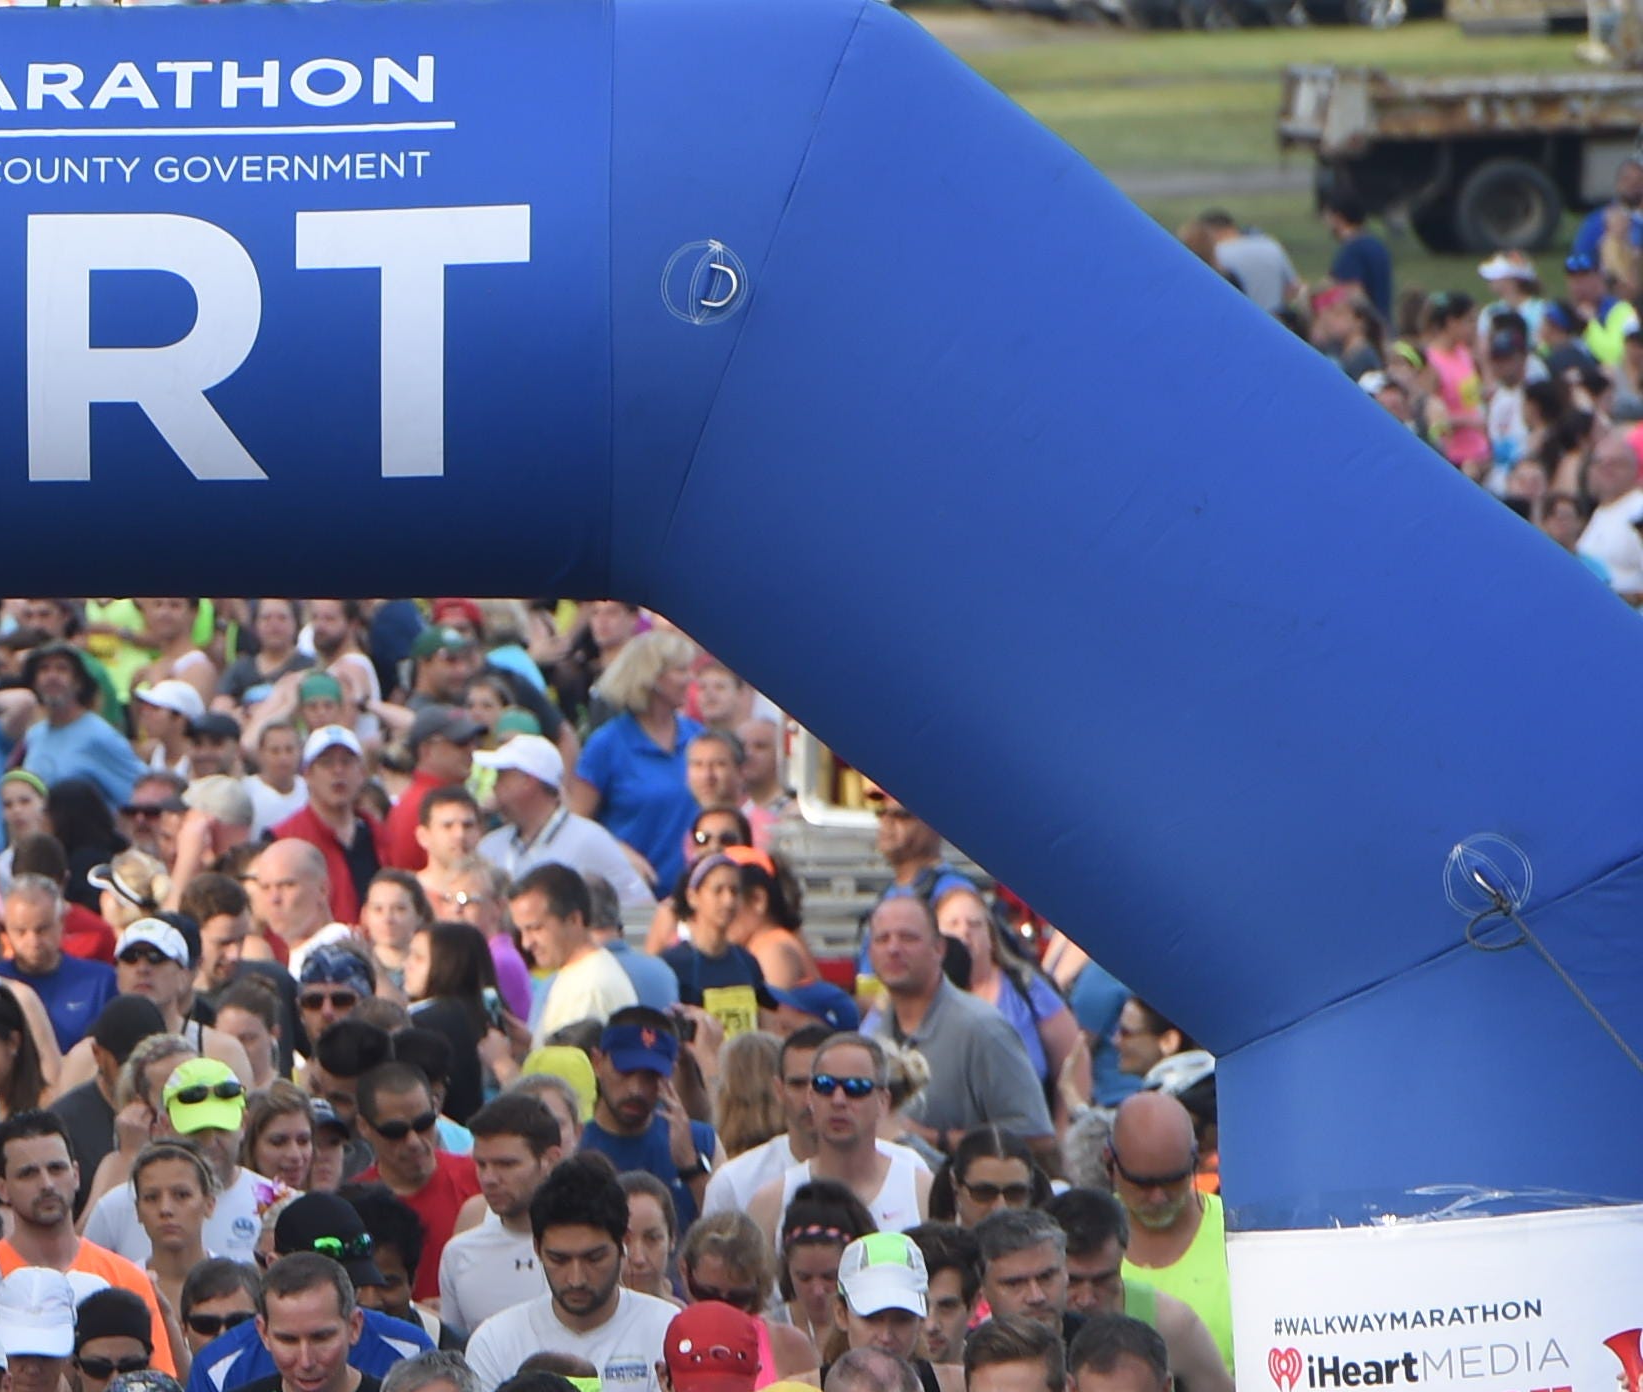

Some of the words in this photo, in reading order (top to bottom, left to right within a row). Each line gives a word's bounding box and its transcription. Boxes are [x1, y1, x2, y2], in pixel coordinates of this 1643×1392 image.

[154, 150, 432, 185] GOVERNMENT
[1274, 1298, 1543, 1337] #WALKWAYMARATHON
[1307, 1337, 1571, 1390] iHeartMEDIA
